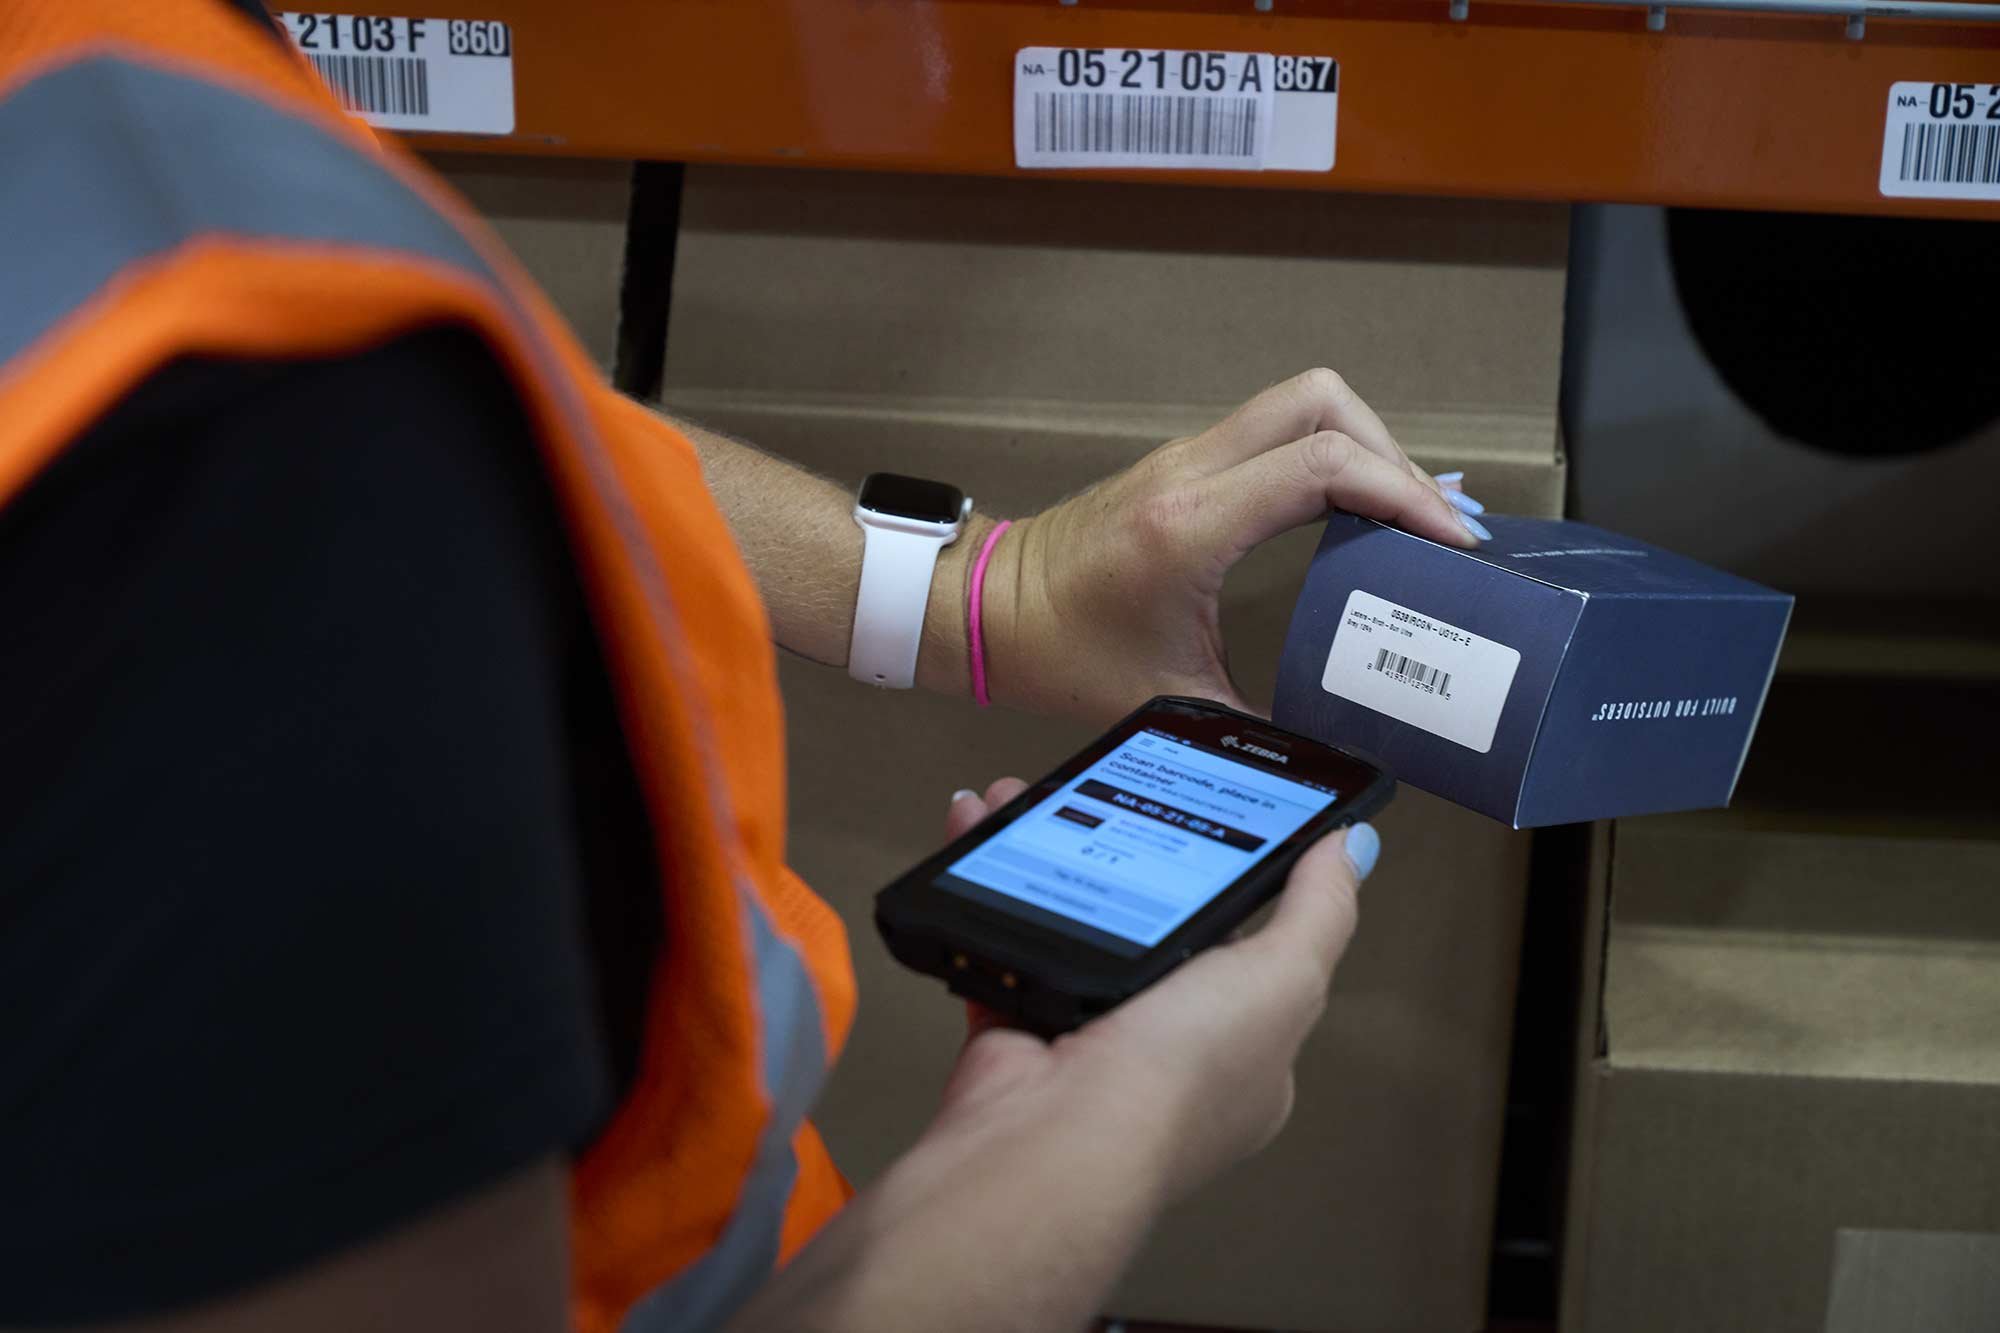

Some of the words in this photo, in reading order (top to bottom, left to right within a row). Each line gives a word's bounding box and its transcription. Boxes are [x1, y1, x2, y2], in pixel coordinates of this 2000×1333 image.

[451, 20, 508, 55] 860
[1022, 48, 1262, 92] NA-05-21-05-A
[1276, 56, 1333, 91] 867
[1675, 699, 1699, 717] FOR
[1702, 697, 1737, 716] BUILT
[1240, 743, 1289, 765] ZEBRA
[1109, 760, 1176, 787] container
[1120, 751, 1155, 769] Scan
[1158, 764, 1214, 791] barcode,
[1218, 785, 1260, 805] place
